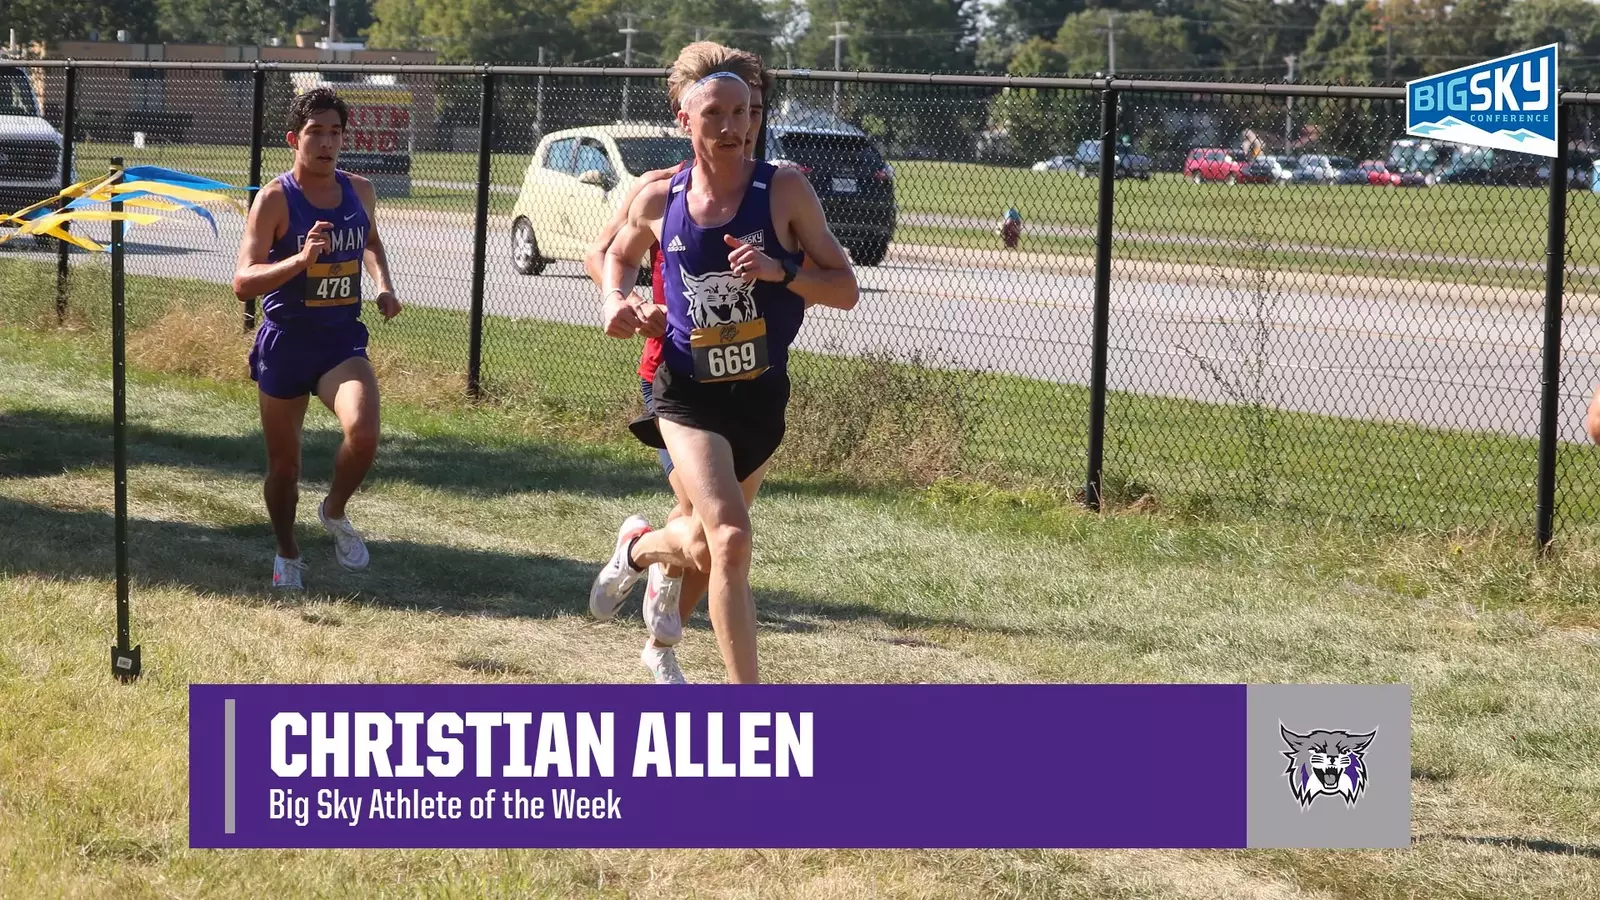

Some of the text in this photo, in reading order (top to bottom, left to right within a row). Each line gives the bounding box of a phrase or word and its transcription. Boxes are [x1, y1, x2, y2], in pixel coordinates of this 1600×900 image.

[297, 226, 364, 253] FMAN
[316, 276, 351, 299] 478
[708, 342, 756, 377] 669
